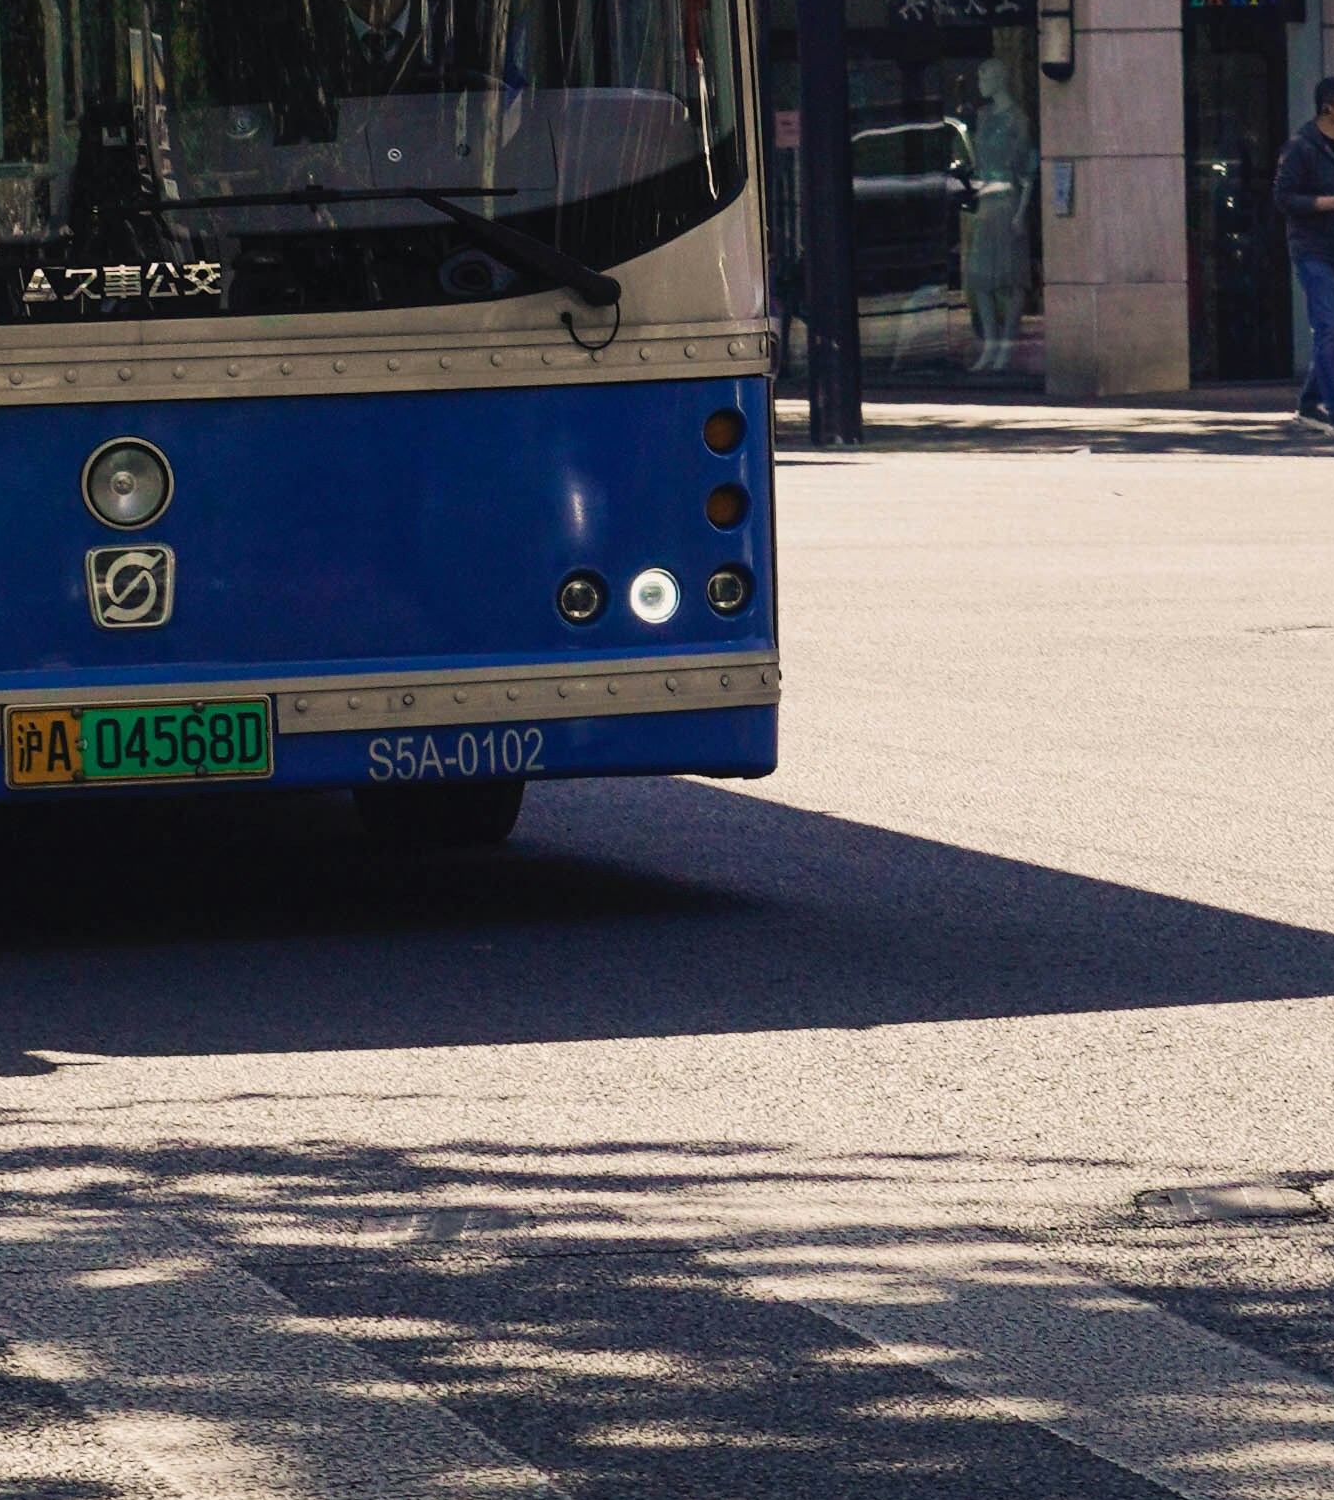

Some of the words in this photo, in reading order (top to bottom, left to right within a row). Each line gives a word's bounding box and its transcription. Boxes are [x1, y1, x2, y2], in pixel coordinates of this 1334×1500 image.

[16, 719, 72, 773] 沪A
[95, 711, 264, 770] 04568D
[368, 727, 546, 782] S5A-0102
